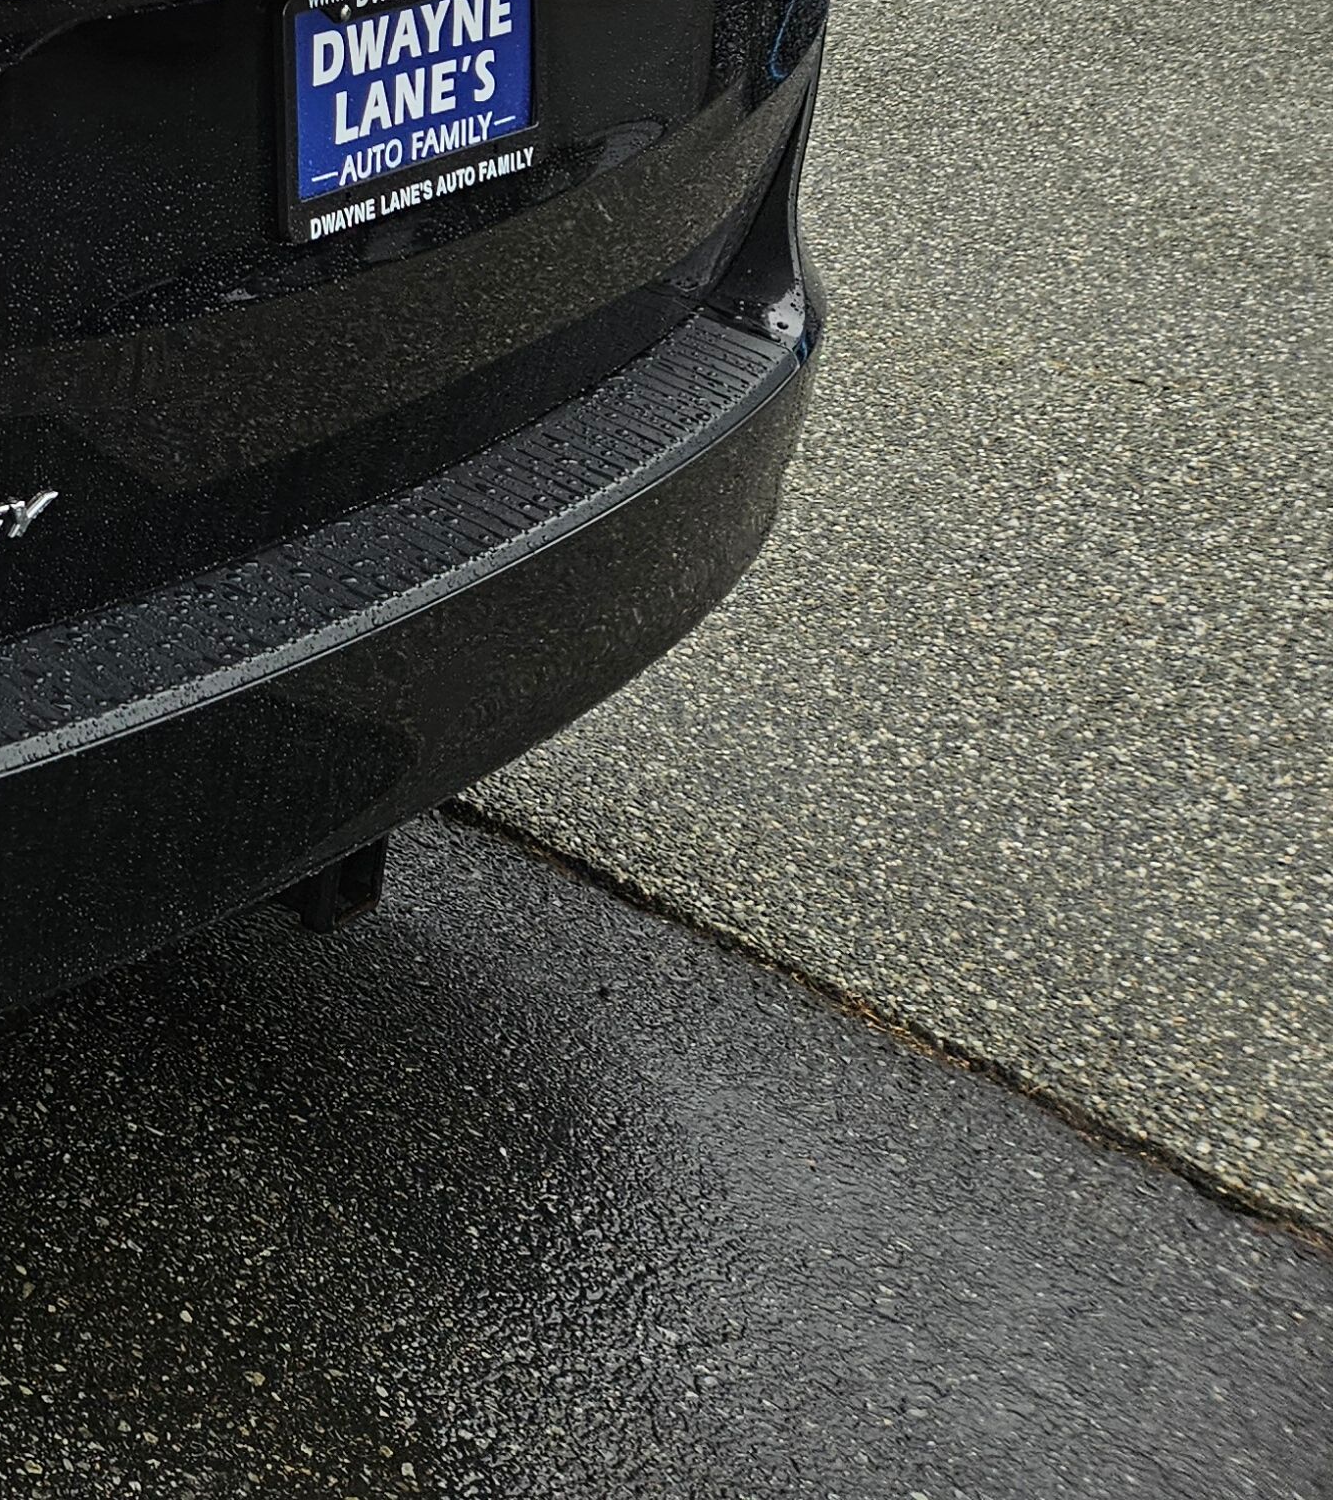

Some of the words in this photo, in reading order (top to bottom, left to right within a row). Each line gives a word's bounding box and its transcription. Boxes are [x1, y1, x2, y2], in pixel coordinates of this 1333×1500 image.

[335, 49, 496, 145] LANE'S
[310, 198, 376, 240] DWAYNE
[380, 179, 433, 215] LANE'S
[436, 165, 476, 197] AUTO
[478, 147, 534, 183] FAMILY
[339, 138, 403, 186] AUTO
[411, 111, 493, 162] FAMILY
